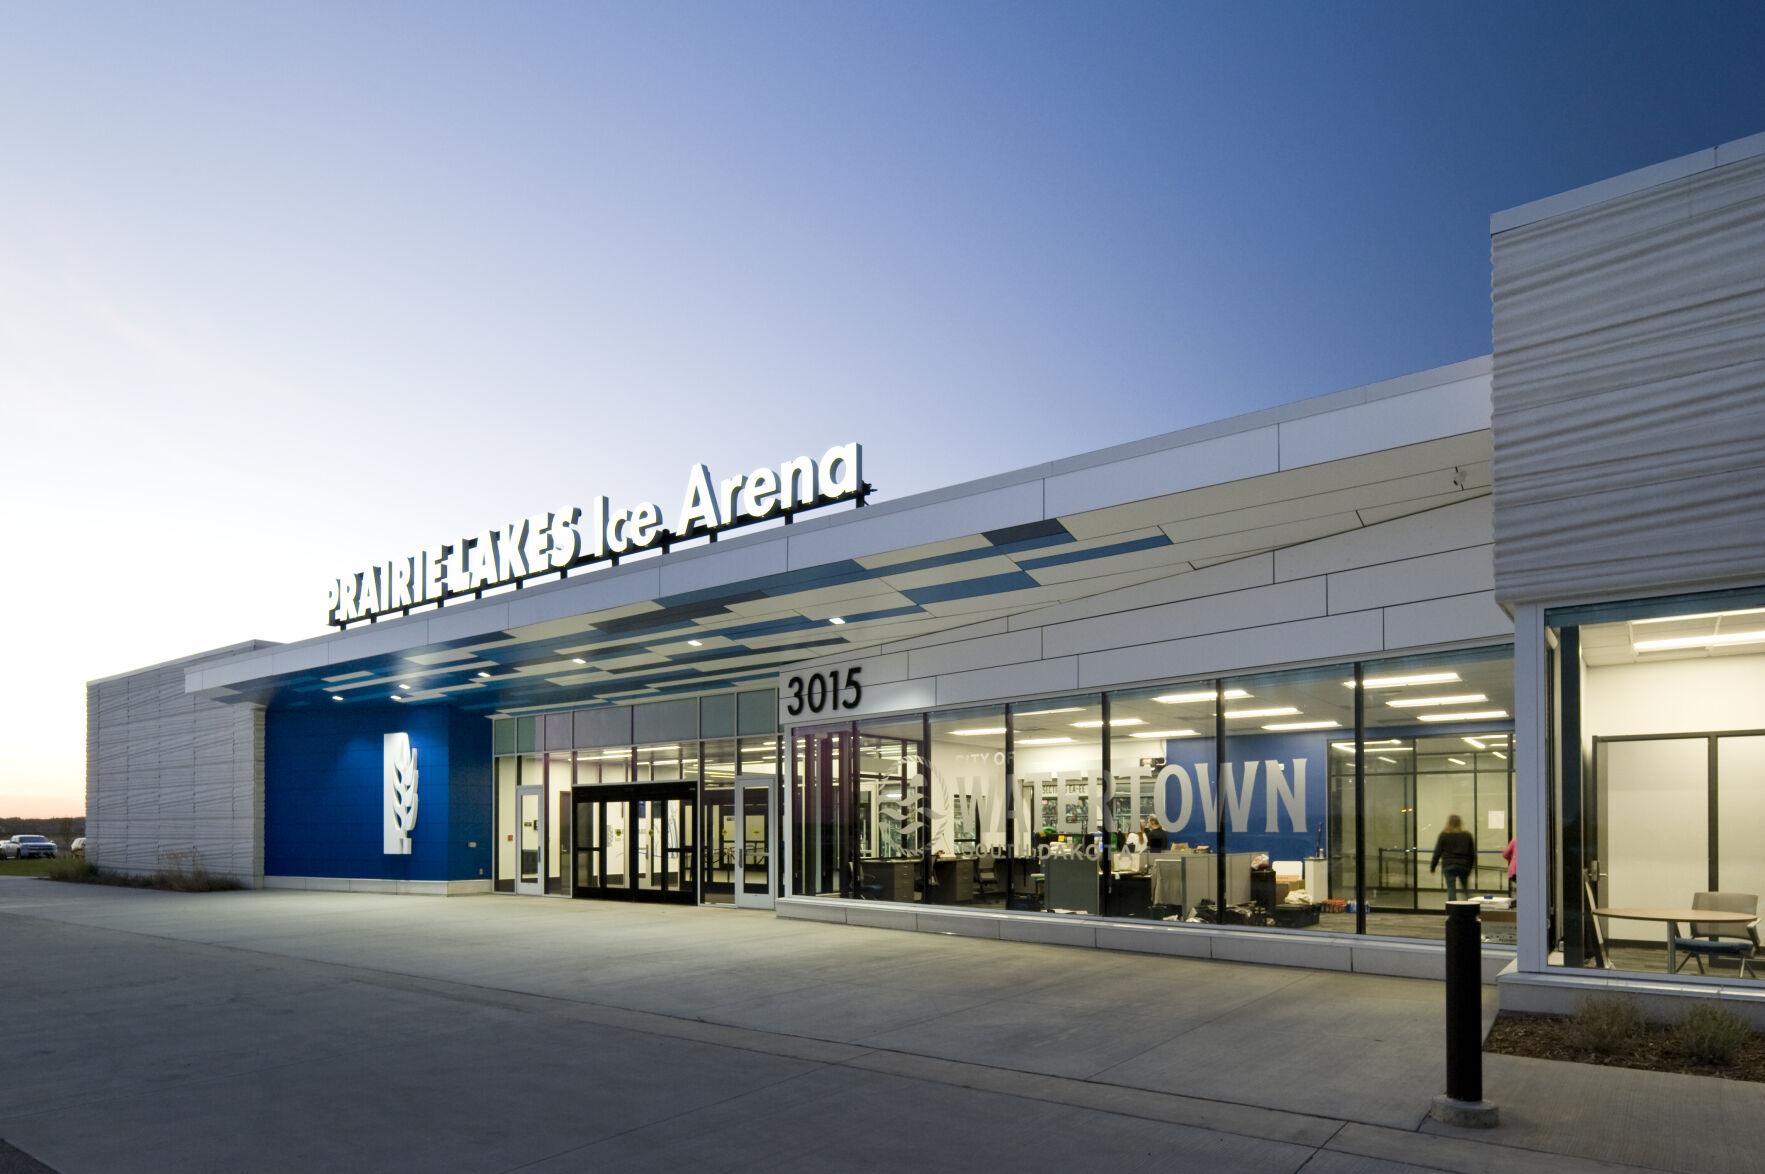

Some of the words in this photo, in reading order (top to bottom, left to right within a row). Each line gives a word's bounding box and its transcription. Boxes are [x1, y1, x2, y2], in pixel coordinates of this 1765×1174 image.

[324, 543, 453, 625] PRAIRIE
[449, 505, 581, 589] LAKES
[594, 495, 663, 556] Ice
[676, 442, 862, 536] Arena
[787, 667, 862, 716] 3015
[955, 752, 990, 766] CITY
[994, 751, 1016, 767] OF
[956, 758, 1308, 833] WATERTOWN
[962, 843, 1029, 859] SOUTH
[1038, 843, 1132, 861] DAKOTA
